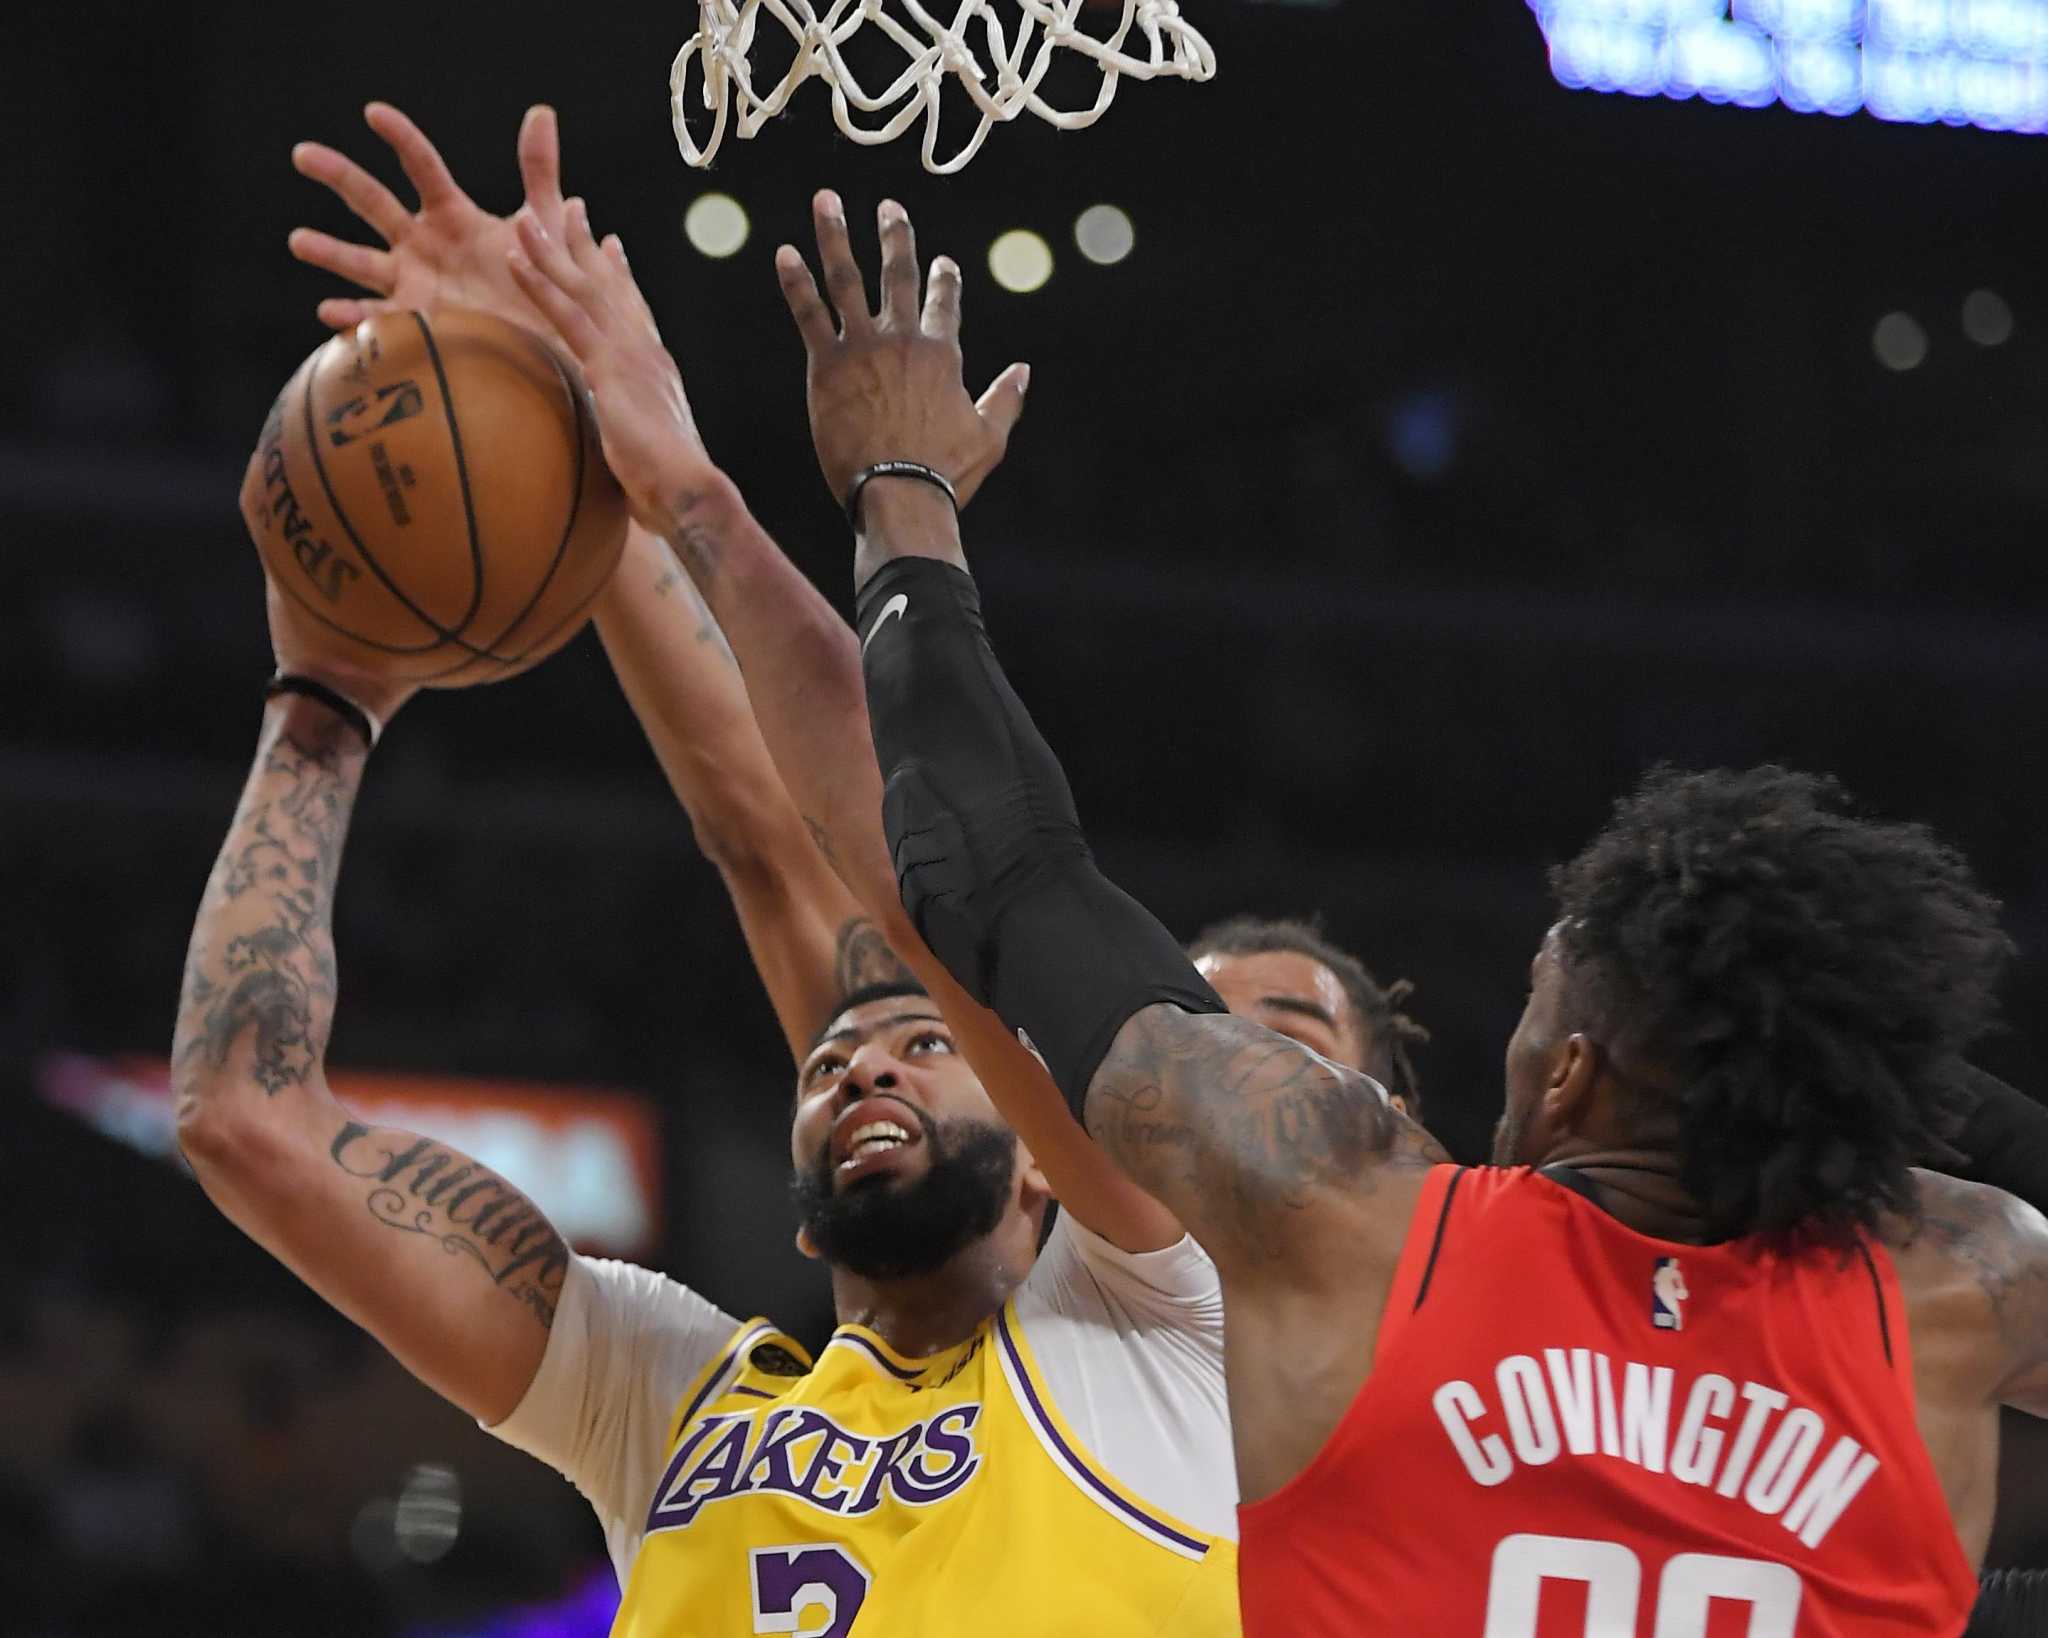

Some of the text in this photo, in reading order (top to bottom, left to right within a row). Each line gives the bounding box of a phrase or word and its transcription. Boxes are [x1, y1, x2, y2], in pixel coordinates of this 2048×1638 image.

[259, 410, 363, 604] SPALD
[643, 1402, 983, 1535] LAKERS
[1432, 1348, 1880, 1550] COVINGTON
